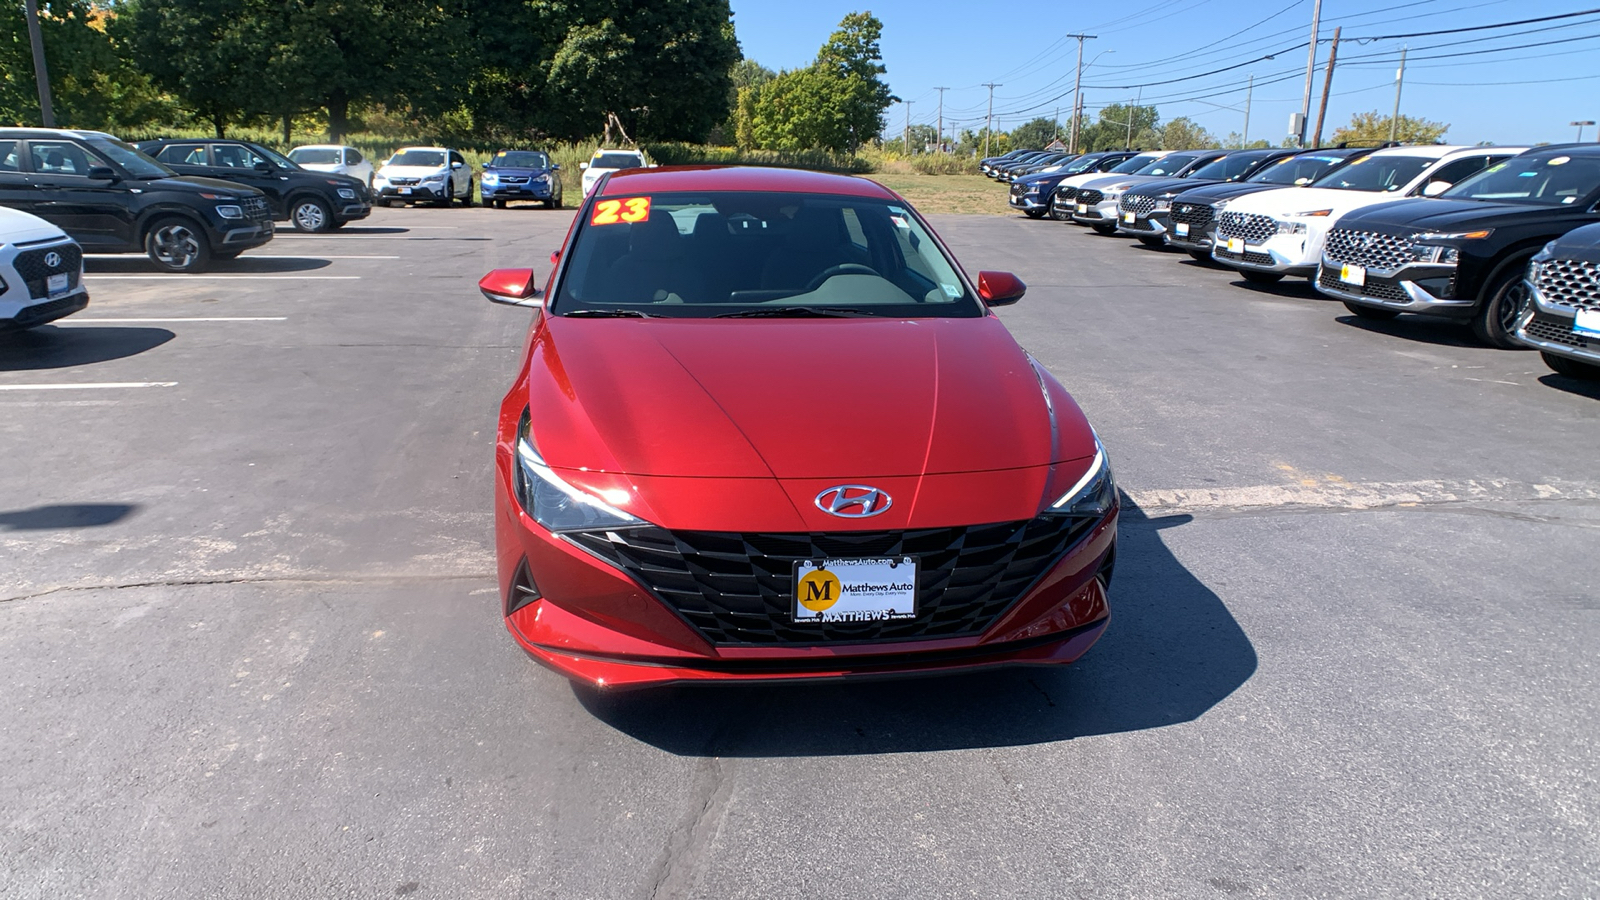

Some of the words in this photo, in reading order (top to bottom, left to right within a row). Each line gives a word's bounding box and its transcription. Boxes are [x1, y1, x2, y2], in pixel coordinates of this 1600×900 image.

[594, 197, 648, 224] 23
[823, 558, 893, 567] MatthewsAuto.com
[804, 580, 833, 602] M
[842, 583, 888, 593] Matthews
[890, 582, 913, 592] Auto
[822, 609, 890, 622] MATTHEWS
